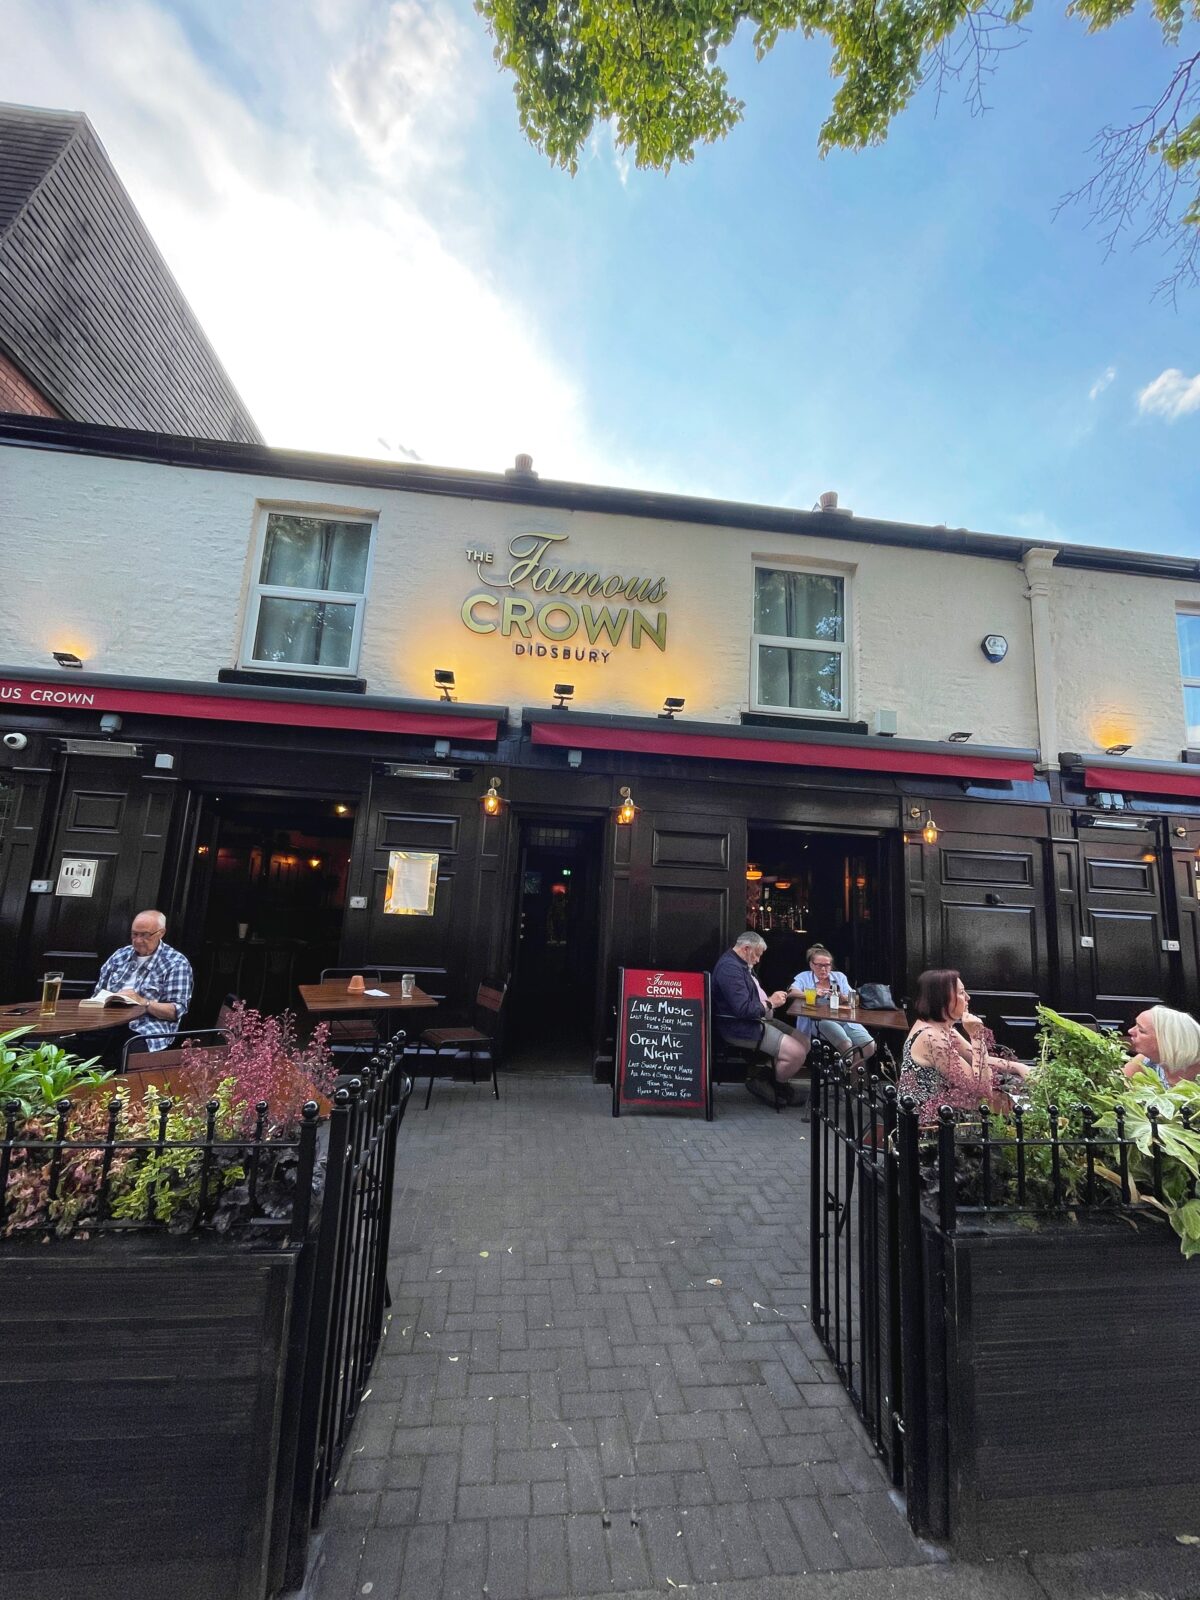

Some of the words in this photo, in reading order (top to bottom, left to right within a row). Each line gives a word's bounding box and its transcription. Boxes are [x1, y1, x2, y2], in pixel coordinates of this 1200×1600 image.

[466, 549, 494, 563] THE
[477, 531, 669, 603] Famous
[461, 594, 667, 652] CROWN
[514, 643, 611, 663] DIDSBURY
[30, 689, 94, 705] CROWN
[647, 986, 682, 995] CROWN
[658, 1001, 693, 1016] MUSIC
[644, 1045, 683, 1062] NIGHT
